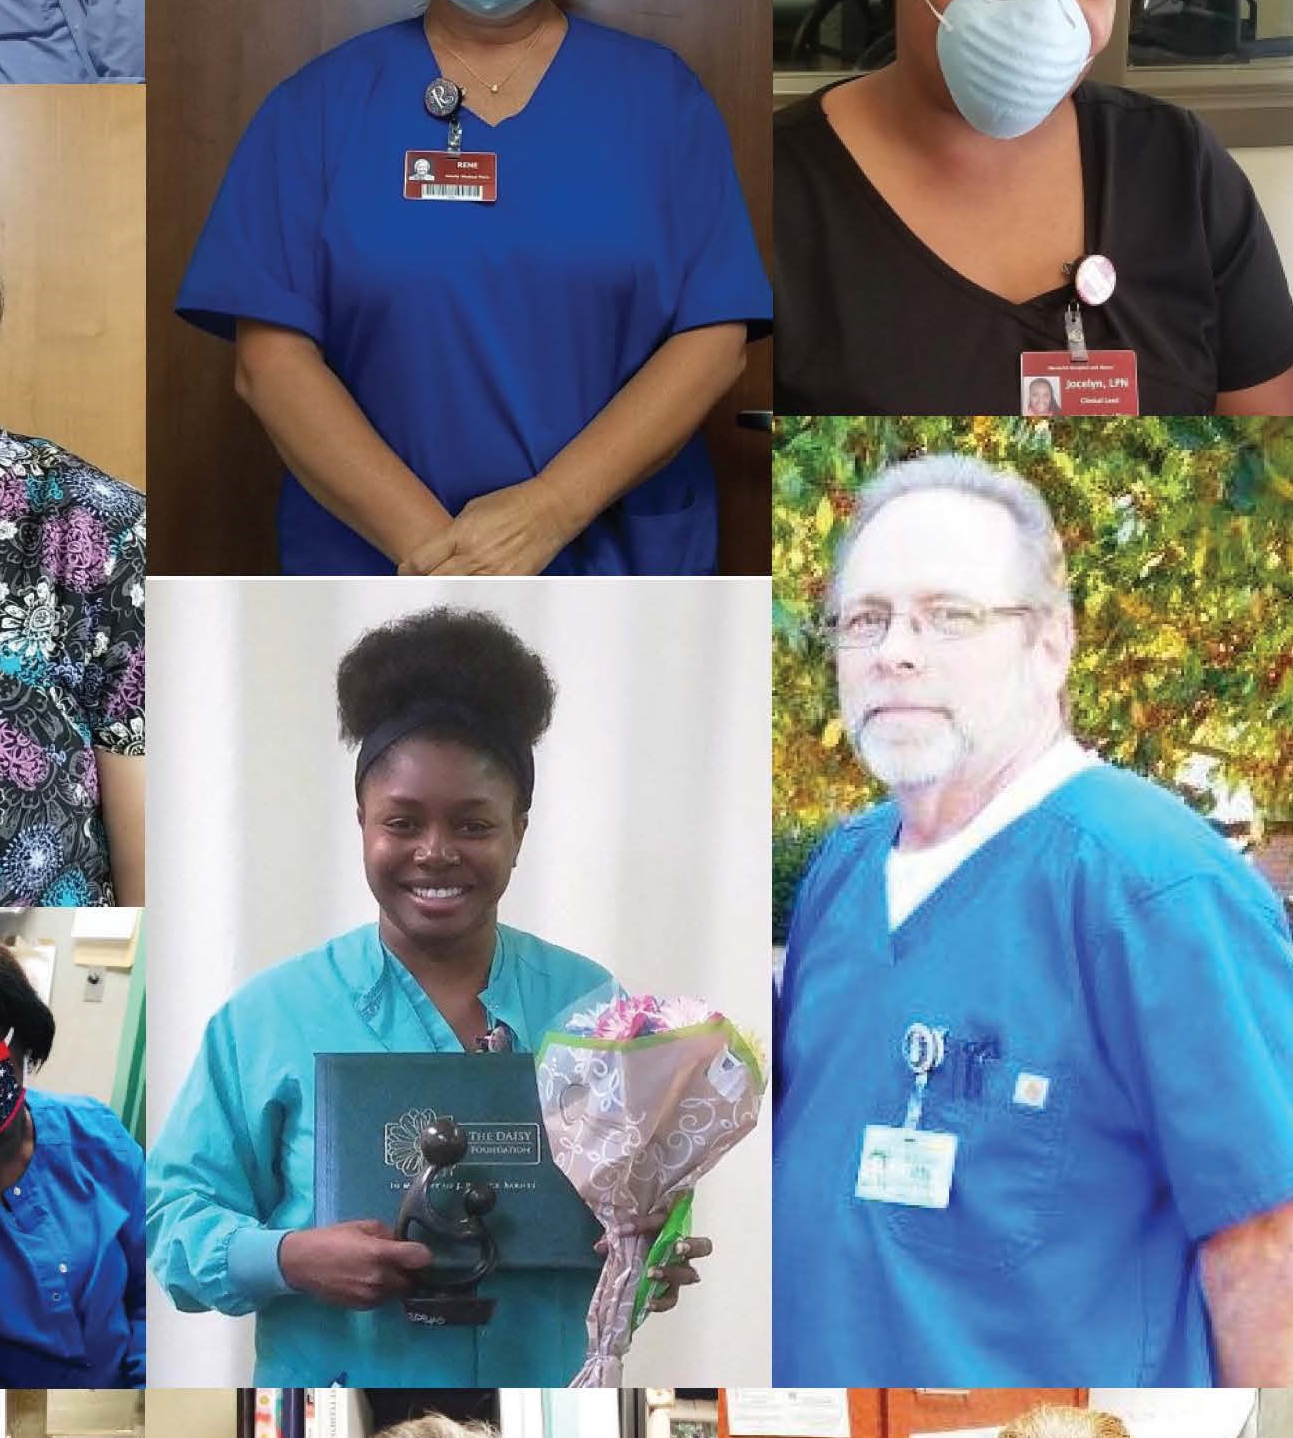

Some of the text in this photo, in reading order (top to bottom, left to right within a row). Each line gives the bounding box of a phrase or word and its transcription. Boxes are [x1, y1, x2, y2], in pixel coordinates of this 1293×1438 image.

[457, 161, 479, 170] RENE
[1108, 377, 1129, 388] LPN
[468, 1130, 533, 1142] THE DAISY
[470, 1145, 531, 1155] FOUNDATION
